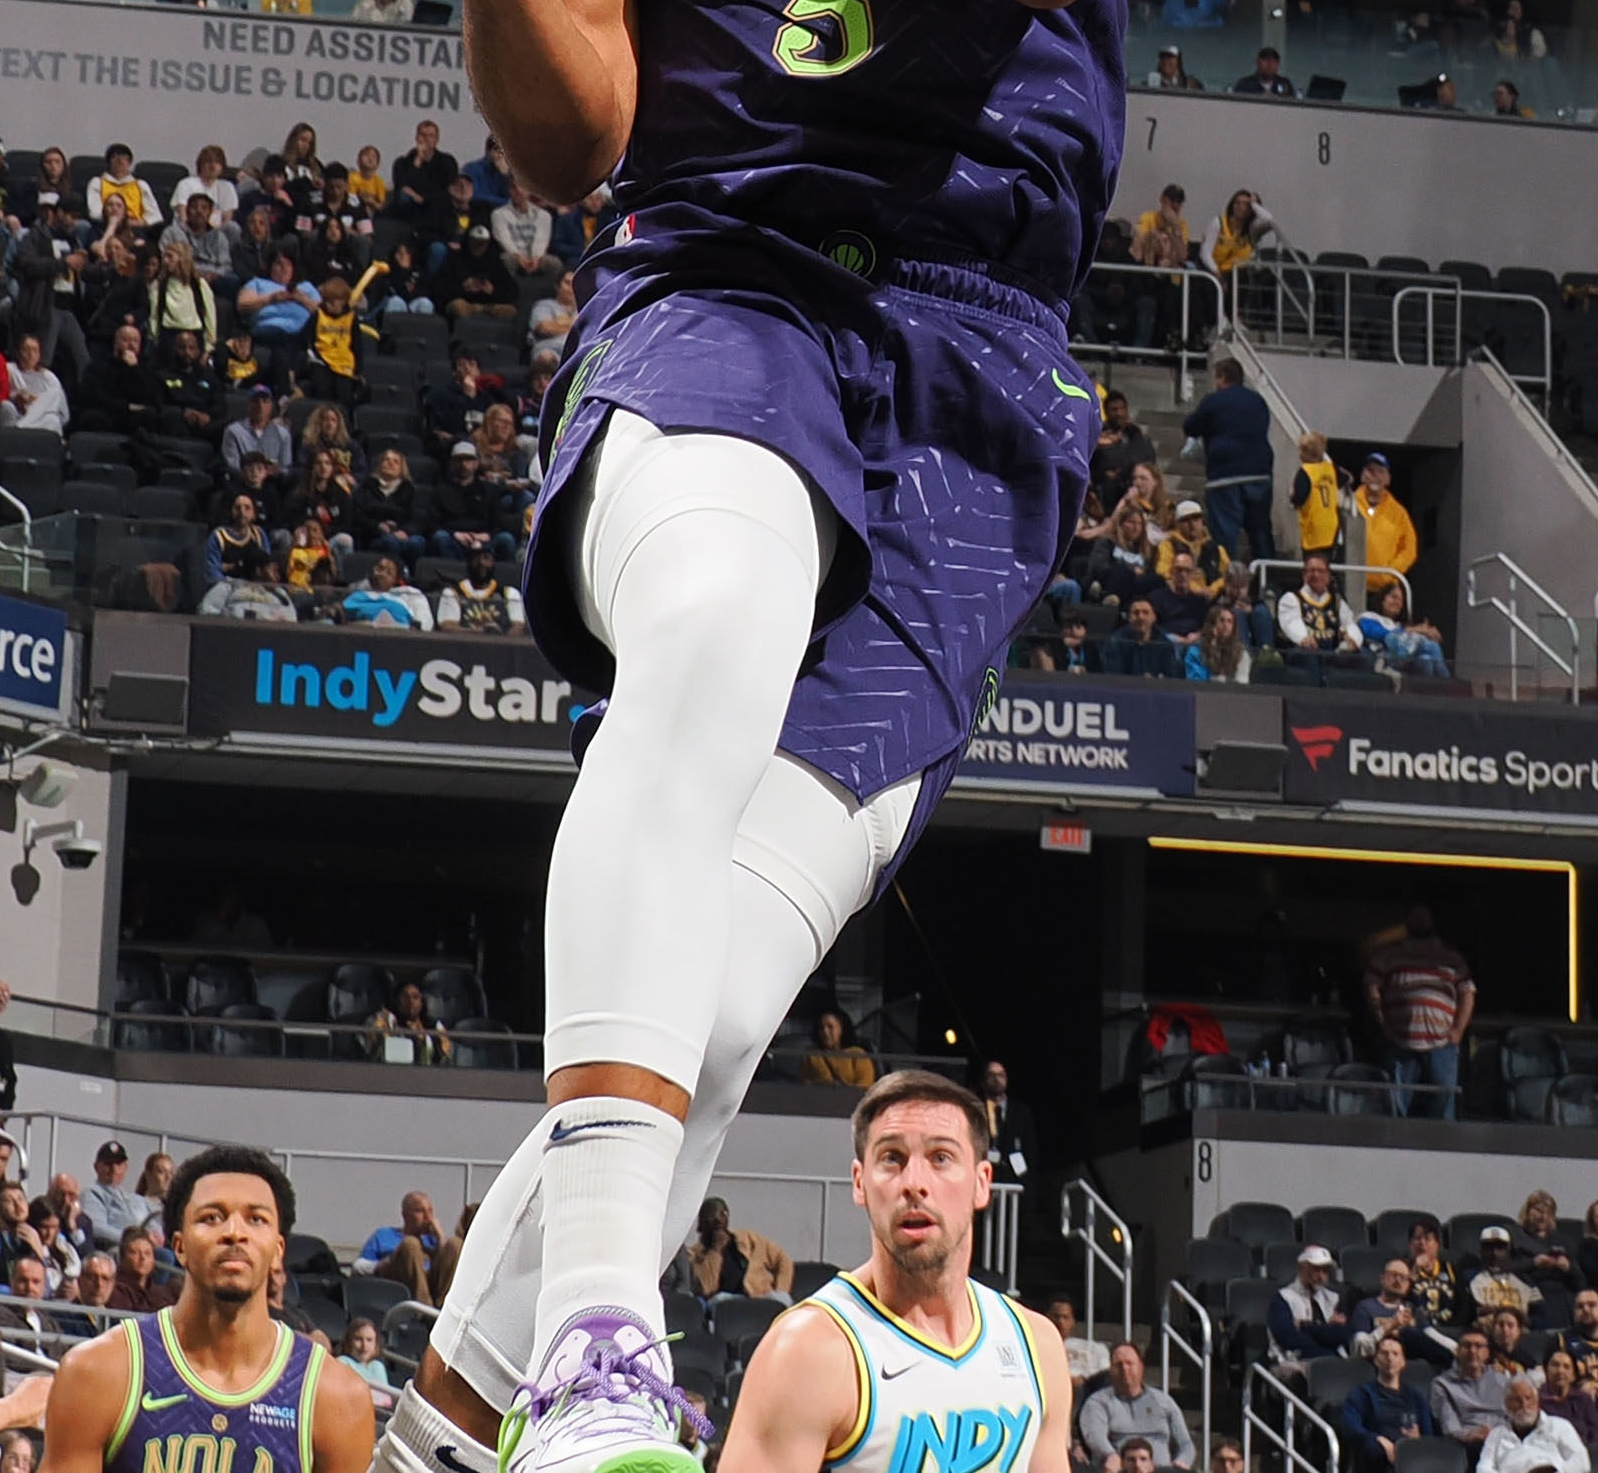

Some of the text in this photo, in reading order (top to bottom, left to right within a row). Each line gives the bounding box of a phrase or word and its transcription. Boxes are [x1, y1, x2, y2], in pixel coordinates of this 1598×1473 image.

[203, 19, 464, 70] NEED ASSISTA
[74, 52, 139, 88] THE
[149, 58, 253, 96] ISSUE
[260, 67, 287, 98] &
[295, 69, 461, 112] LOCATION
[1146, 117, 1157, 152] 7
[1319, 131, 1331, 166] 8
[979, 696, 1130, 741] NDUEL
[1016, 742, 1129, 770] NETWORK
[1348, 736, 1499, 784] Fanatics
[1198, 1141, 1212, 1183] 8
[249, 1402, 297, 1419] NEWAGE
[886, 1402, 1033, 1473] INDY
